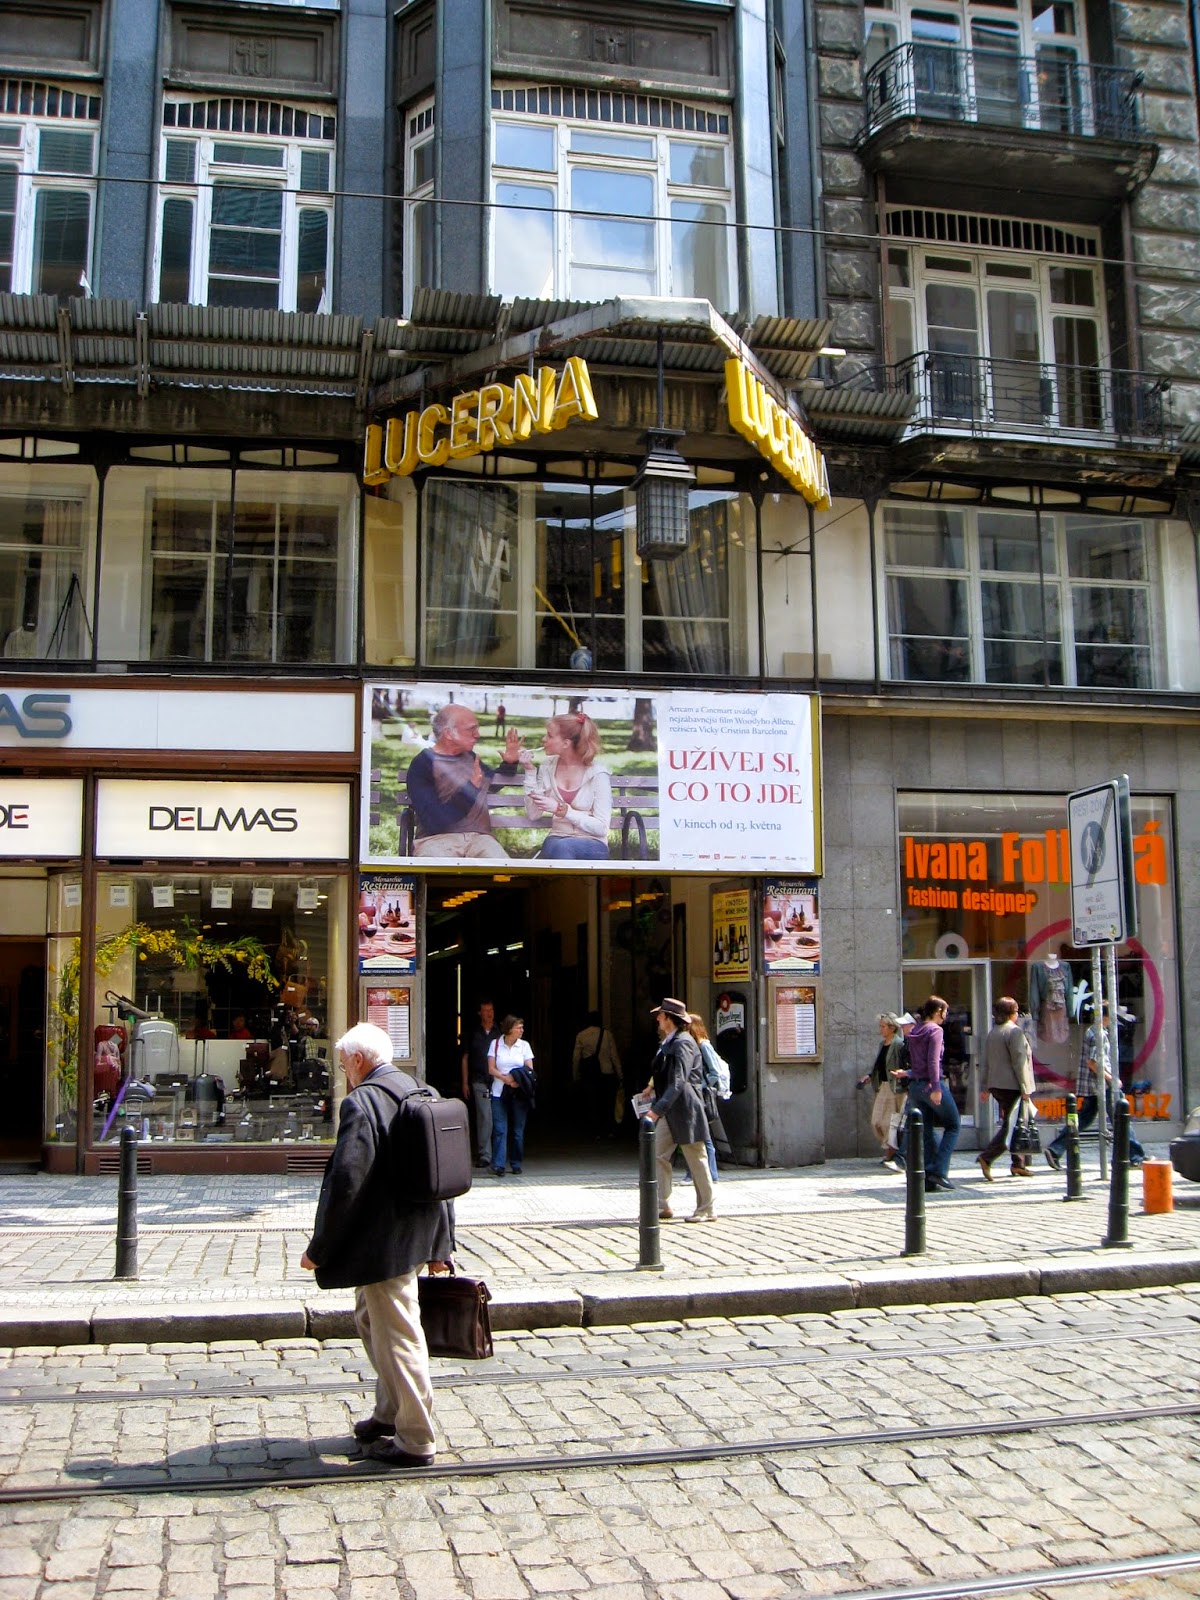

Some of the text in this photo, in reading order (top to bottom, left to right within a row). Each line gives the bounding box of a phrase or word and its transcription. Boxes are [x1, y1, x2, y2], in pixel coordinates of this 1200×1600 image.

[364, 356, 599, 486] LUCERNA
[724, 358, 832, 512] LUCERNA
[700, 706, 733, 715] Cinemart
[719, 716, 734, 724] film
[734, 717, 771, 727] Woodyho
[698, 726, 719, 736] Vicky
[720, 726, 750, 735] Cristina
[751, 727, 788, 736] Barcelona
[668, 746, 800, 776] UŽÍVEJ SI,
[668, 781, 802, 805] CO TO JDE
[149, 806, 298, 832] DELMAS
[673, 818, 682, 828] V
[684, 818, 717, 829] kinech
[719, 818, 733, 830] od
[750, 820, 782, 831] května
[904, 820, 1168, 886] Ivana Follá
[361, 880, 415, 894] Restaurant
[766, 885, 818, 898] Restaurant
[907, 886, 1037, 916] fashion designer
